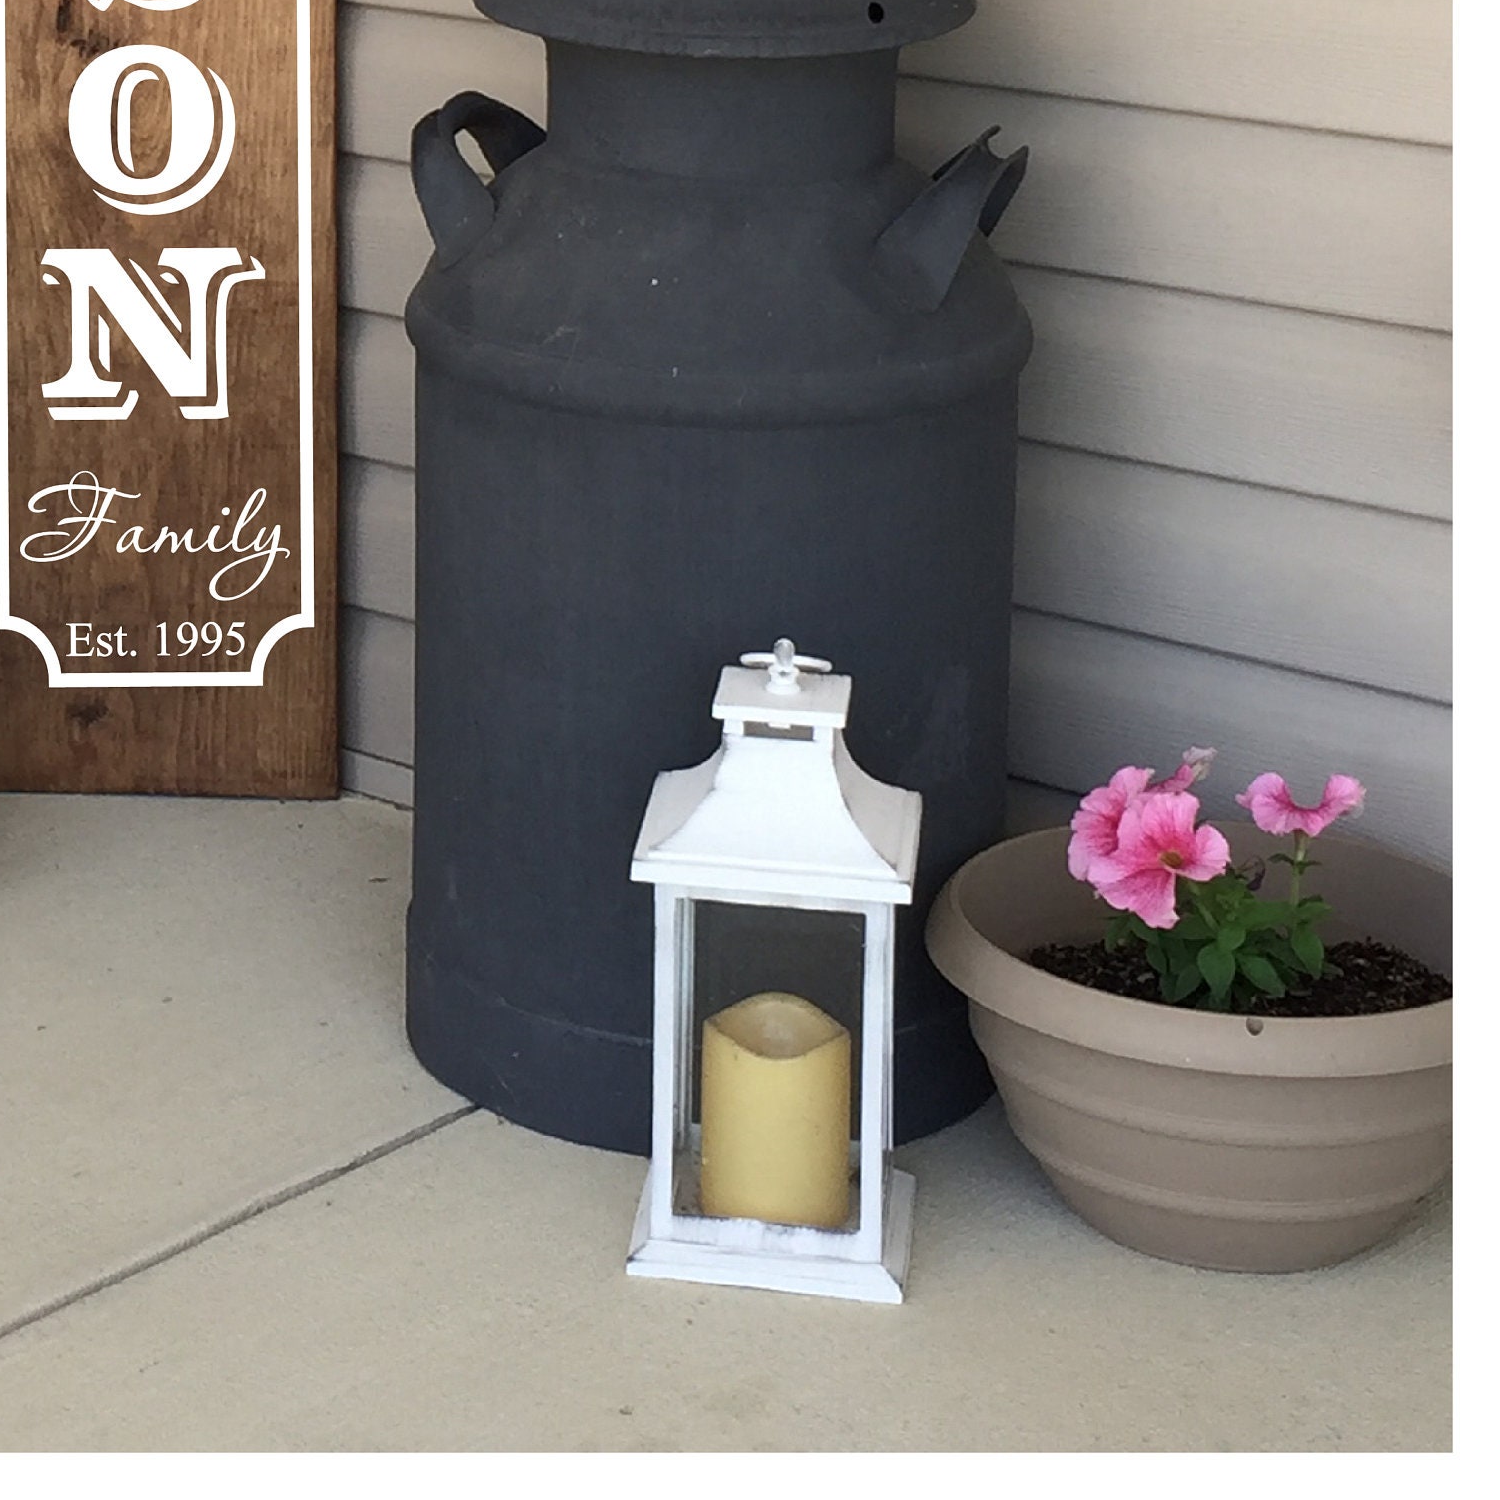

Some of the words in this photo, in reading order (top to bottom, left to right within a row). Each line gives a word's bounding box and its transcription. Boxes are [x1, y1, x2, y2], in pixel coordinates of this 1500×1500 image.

[19, 470, 291, 601] Family
[65, 622, 138, 658] Est.
[155, 621, 246, 657] 1995
